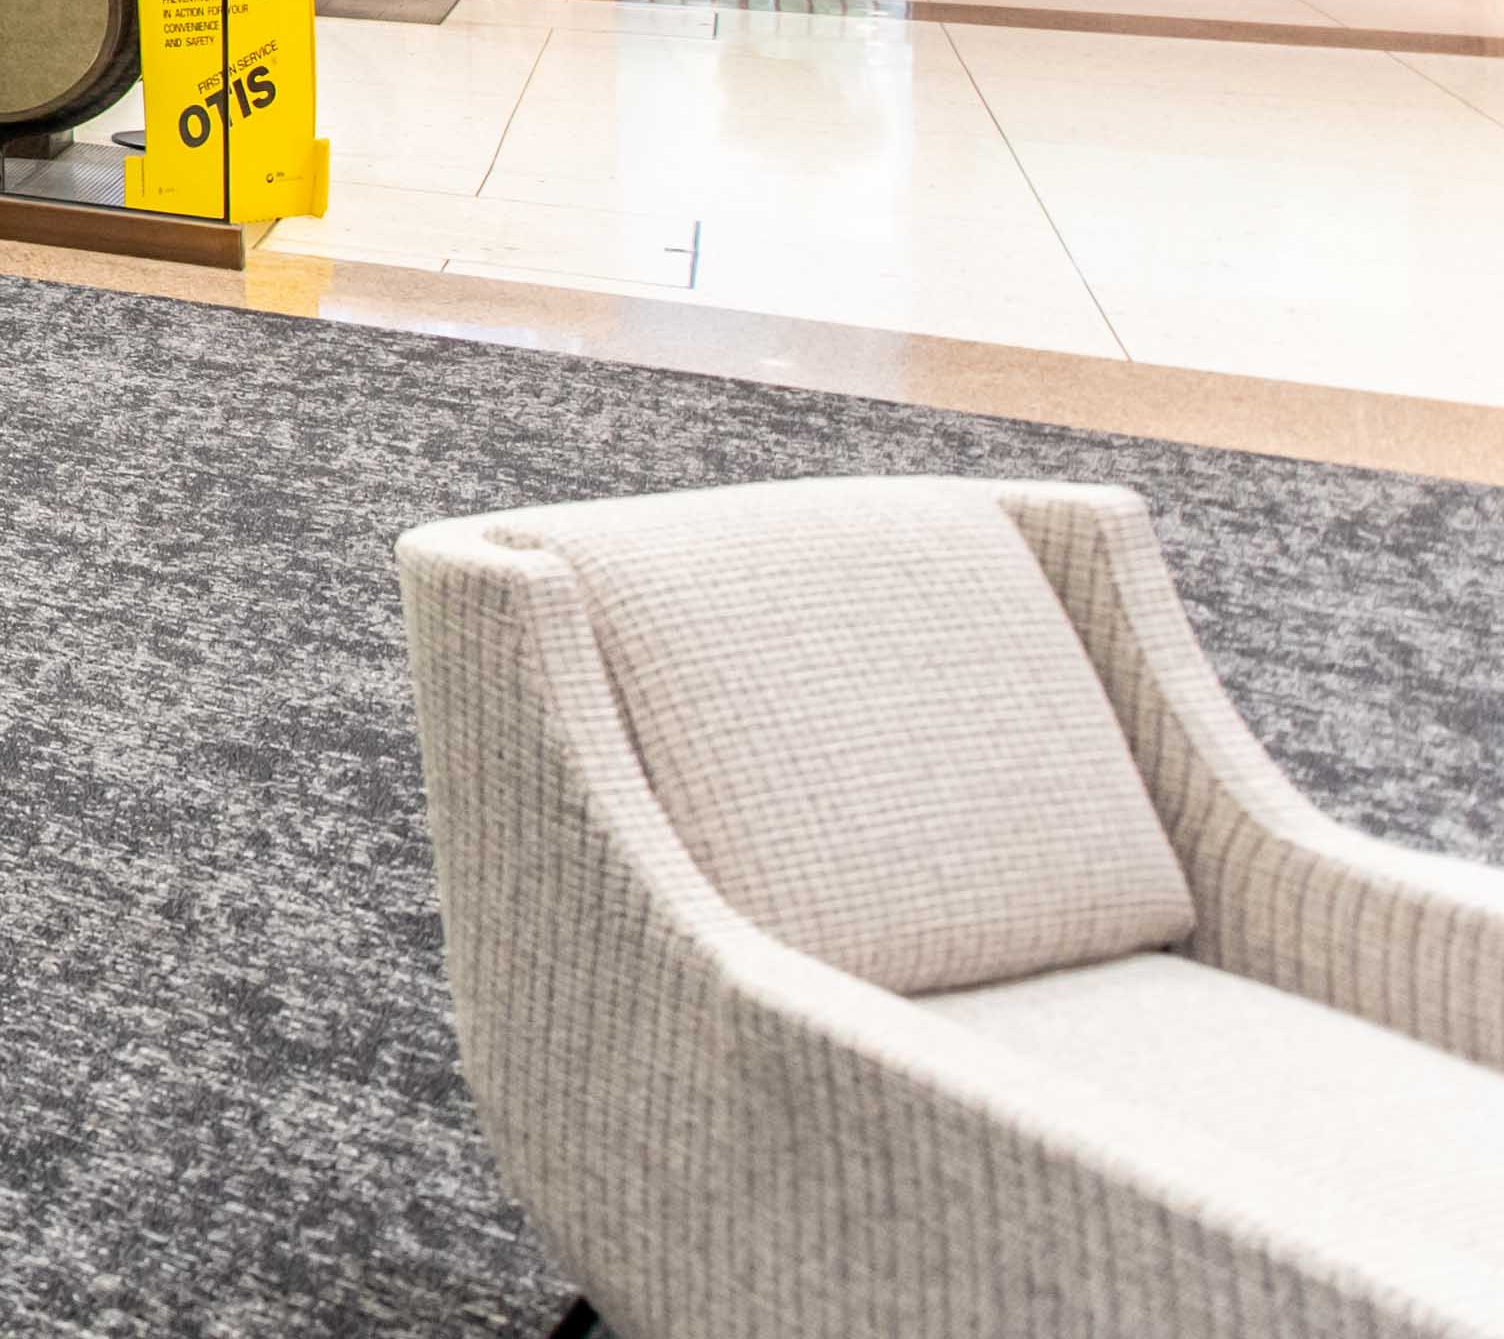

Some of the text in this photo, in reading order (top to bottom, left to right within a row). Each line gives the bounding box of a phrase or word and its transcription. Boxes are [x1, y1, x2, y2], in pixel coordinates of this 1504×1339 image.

[163, 9, 171, 19] IN
[175, 7, 205, 18] ACTION
[163, 21, 220, 34] CONVENIENCE
[164, 36, 216, 49] AND SAFETY
[237, 39, 279, 71] SERVICE
[178, 65, 277, 148] OTIS
